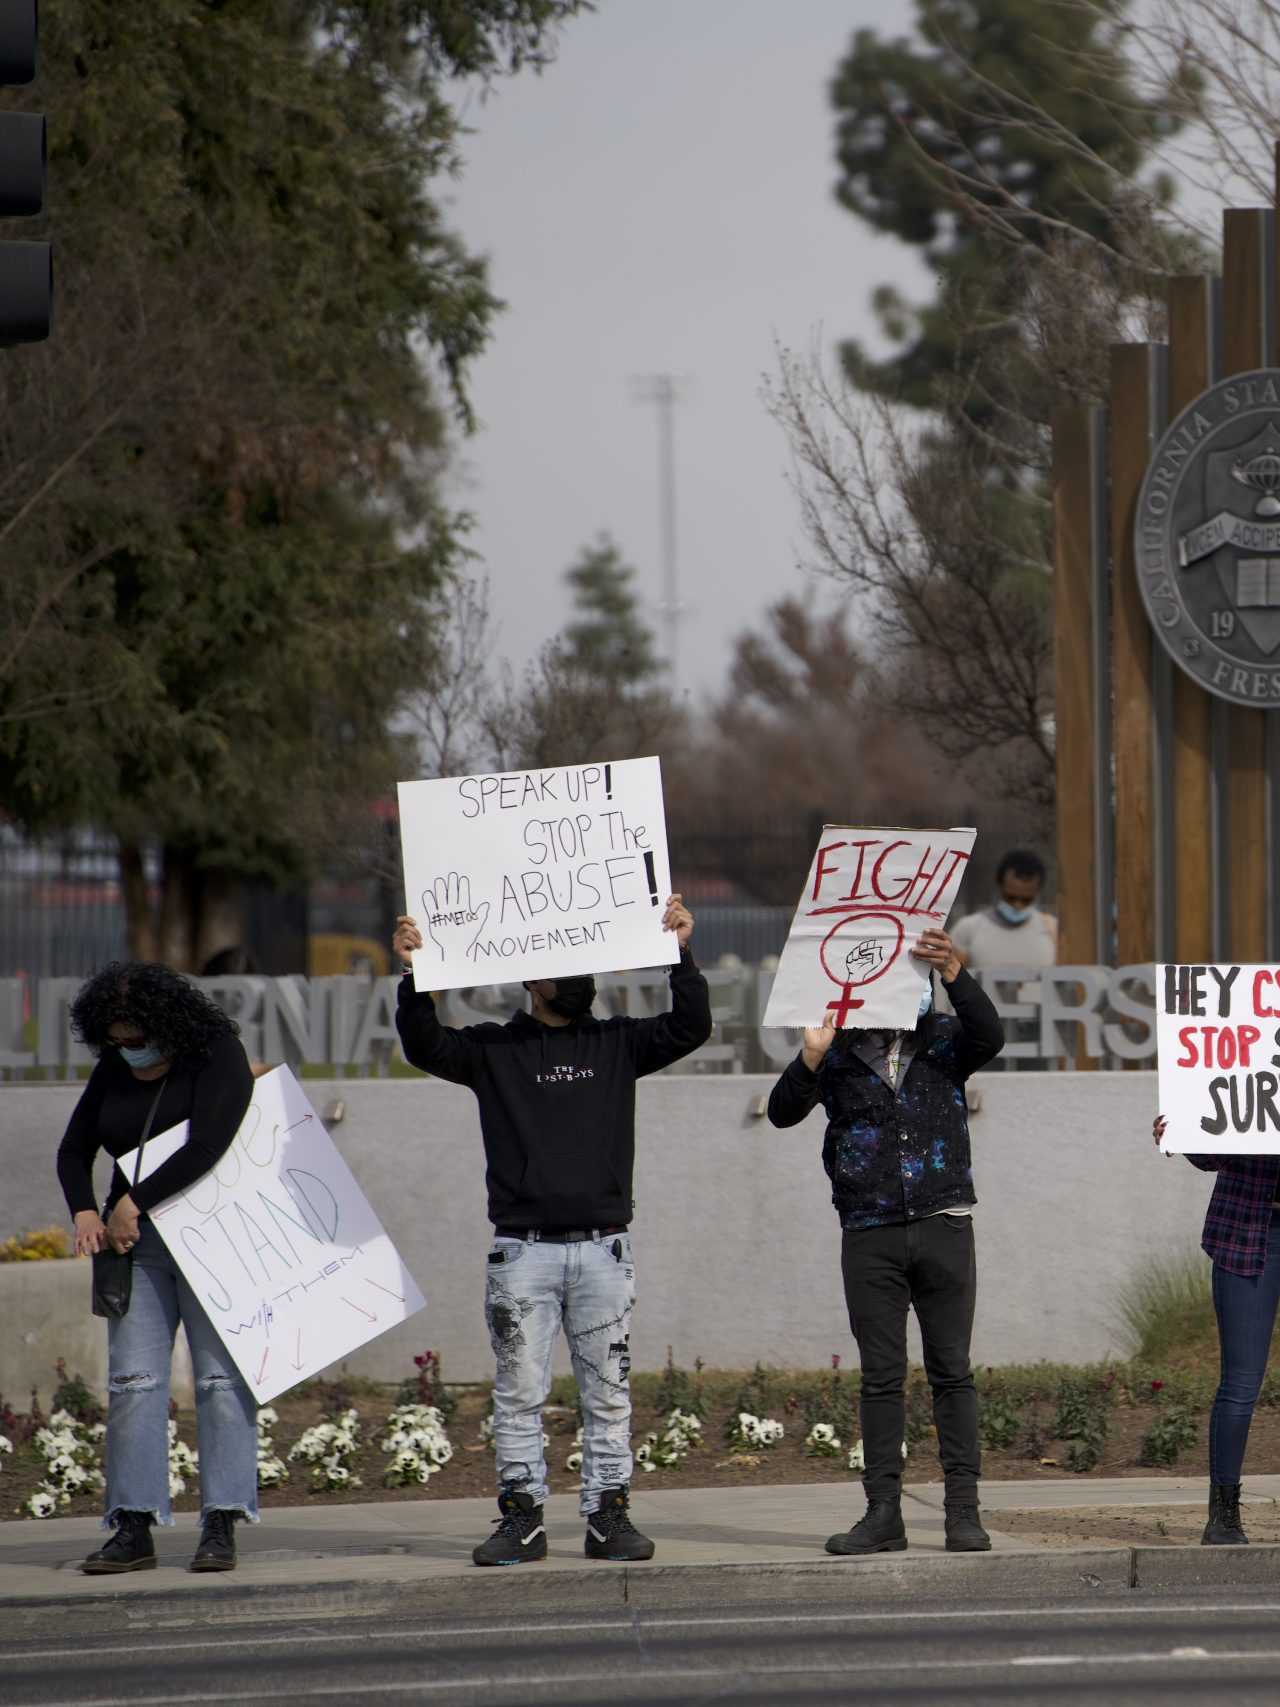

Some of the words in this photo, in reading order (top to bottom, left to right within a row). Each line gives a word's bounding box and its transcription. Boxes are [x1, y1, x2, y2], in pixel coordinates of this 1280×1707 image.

[1147, 411, 1213, 627] CALIFORNIA
[1186, 519, 1225, 556] CEM
[1211, 611, 1235, 637] 19
[459, 772, 558, 818] SPEAK
[566, 764, 613, 800] UP!
[524, 814, 592, 865] STOP
[600, 811, 651, 850] The
[500, 851, 659, 924] ABUSE!
[812, 840, 970, 915] FIGHT
[474, 920, 611, 962] MOVEMENT
[1164, 965, 1241, 1018] HEY
[1177, 1024, 1261, 1069] STOP
[179, 1168, 338, 1313] STAND
[272, 1245, 365, 1303] THEM
